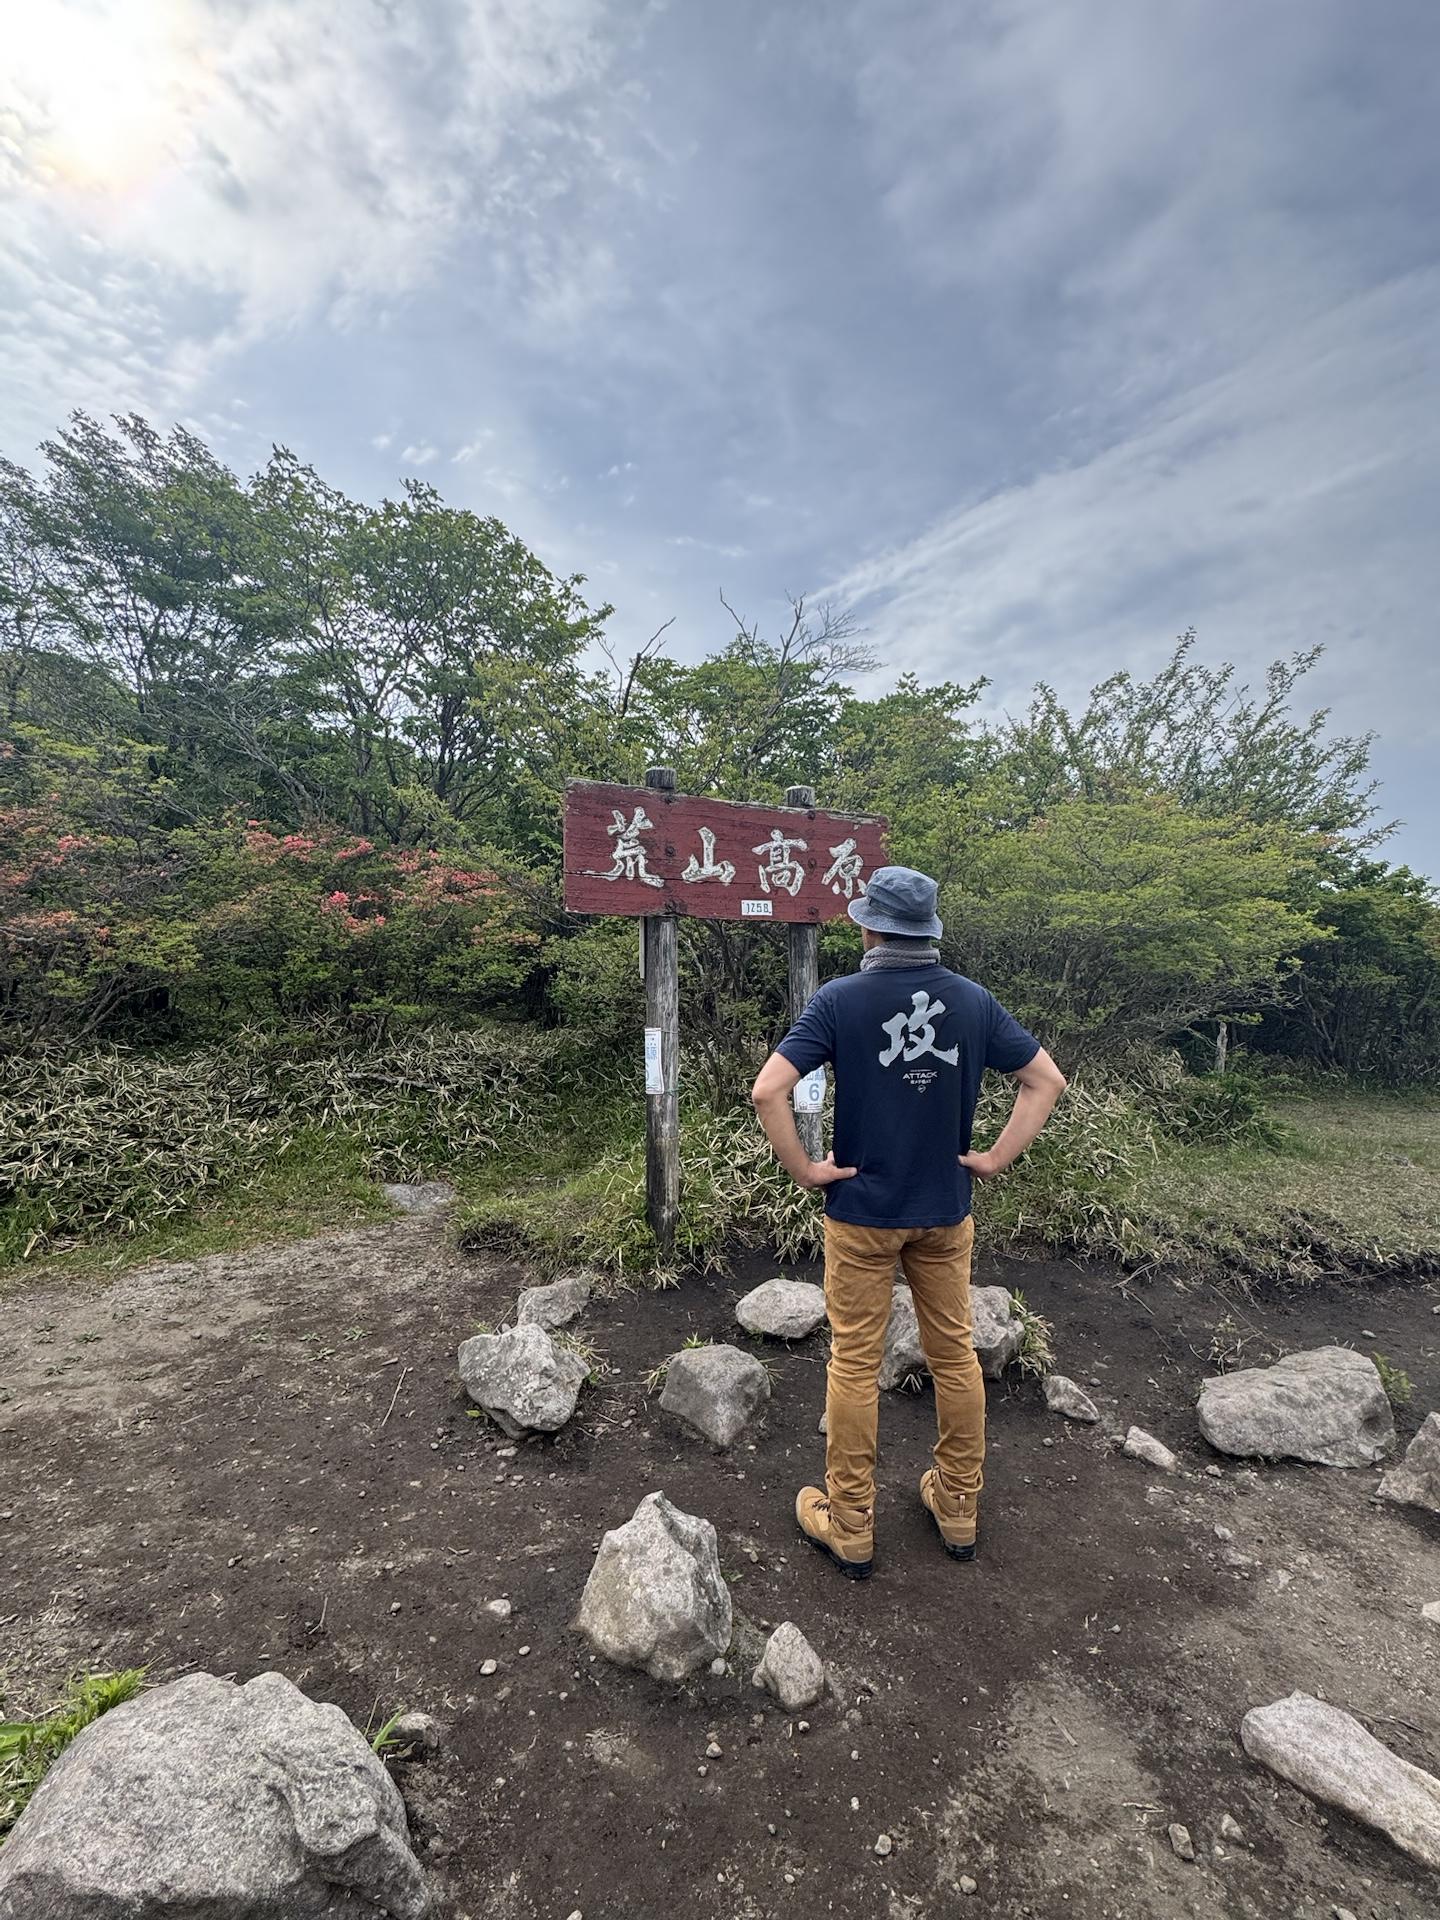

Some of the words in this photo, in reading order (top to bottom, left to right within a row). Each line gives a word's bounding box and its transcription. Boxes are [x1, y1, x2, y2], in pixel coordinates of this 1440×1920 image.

[879, 990, 959, 1067] 攻
[903, 1071, 938, 1080] ATTACK
[809, 1083, 820, 1102] 6
